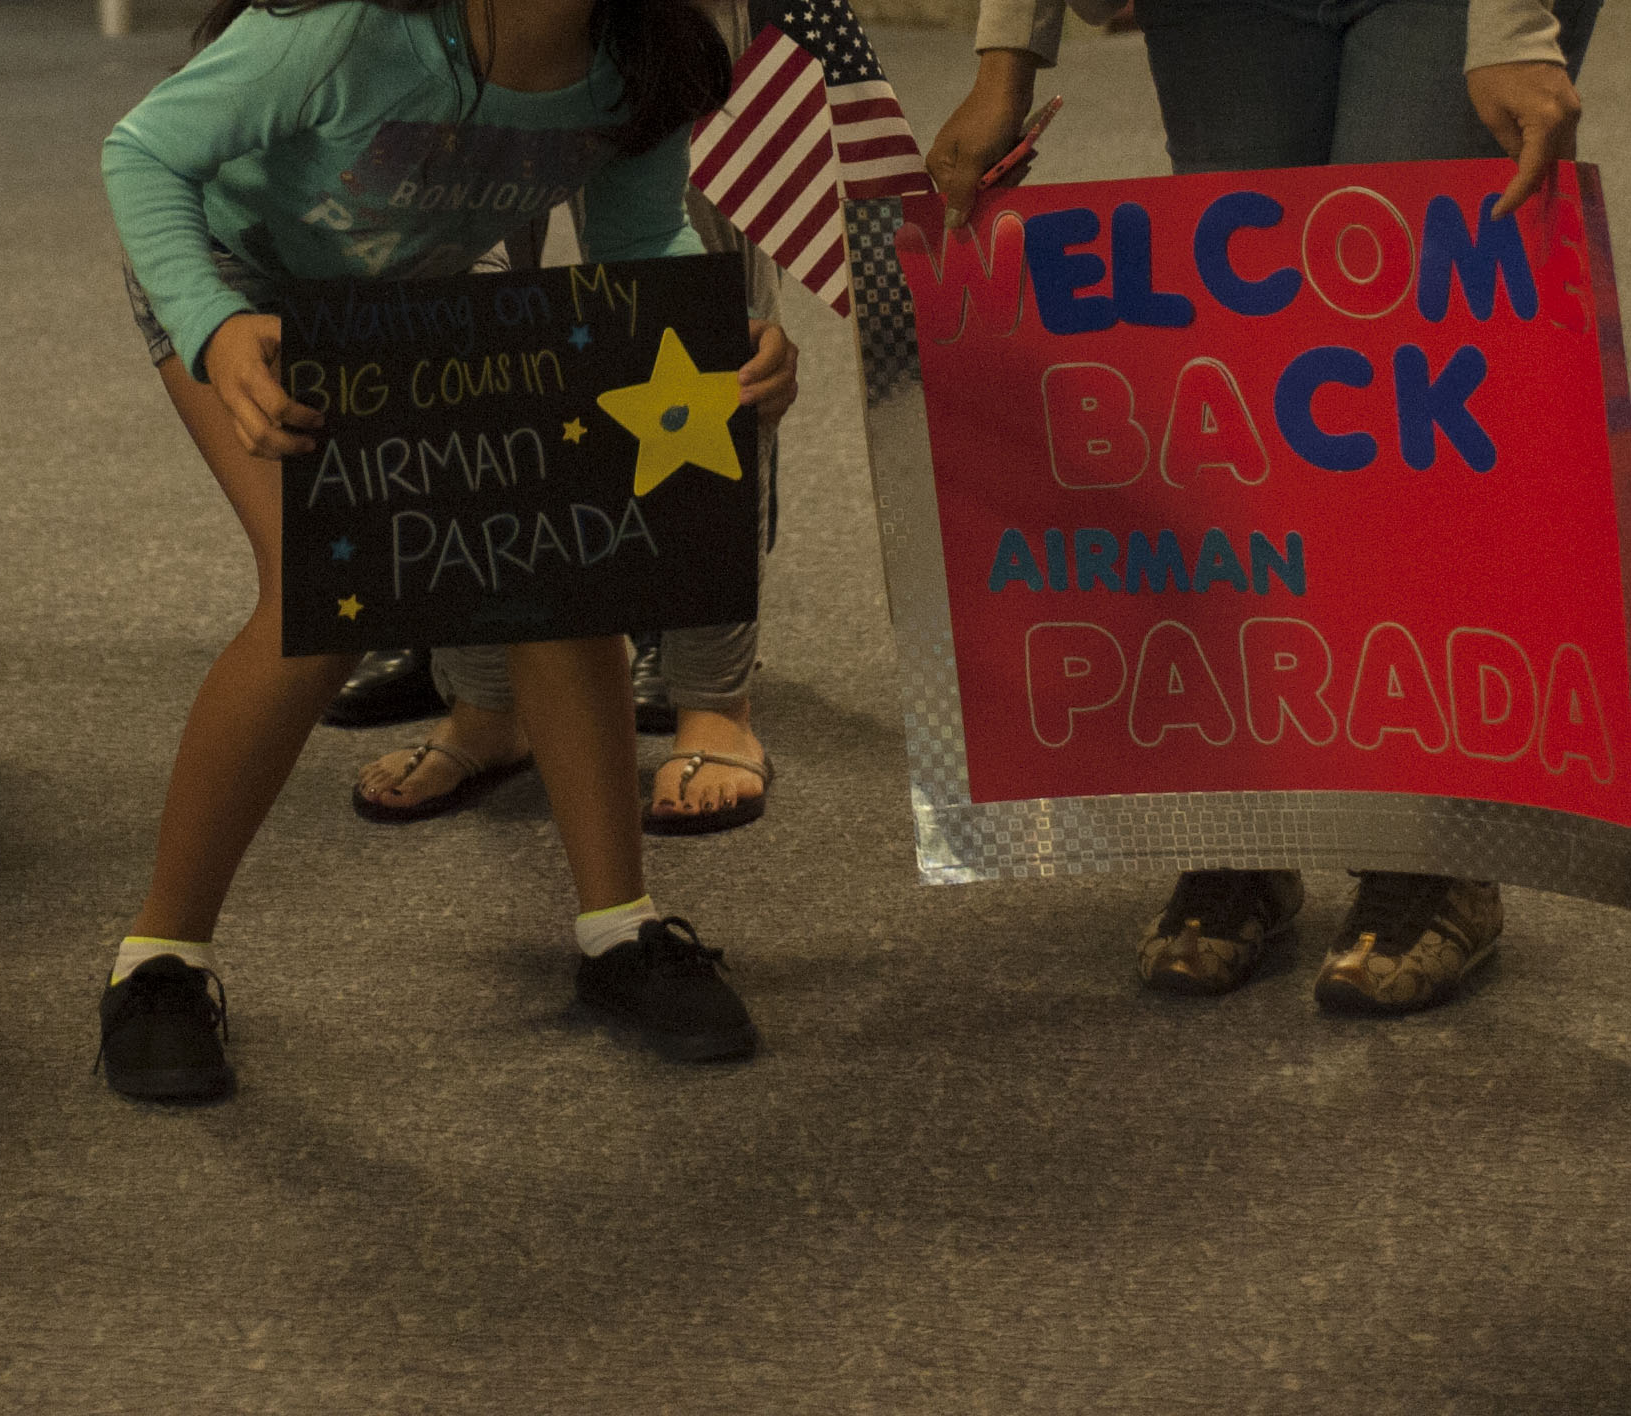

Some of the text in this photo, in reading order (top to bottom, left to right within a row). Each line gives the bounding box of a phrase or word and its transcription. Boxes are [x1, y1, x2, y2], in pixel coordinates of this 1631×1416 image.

[568, 263, 638, 338] My
[288, 359, 389, 416] BIG
[1042, 344, 1497, 489] BACK
[391, 498, 660, 601] PARADA
[988, 527, 1307, 597] AIRMAN
[1024, 617, 1616, 786] PARADA
